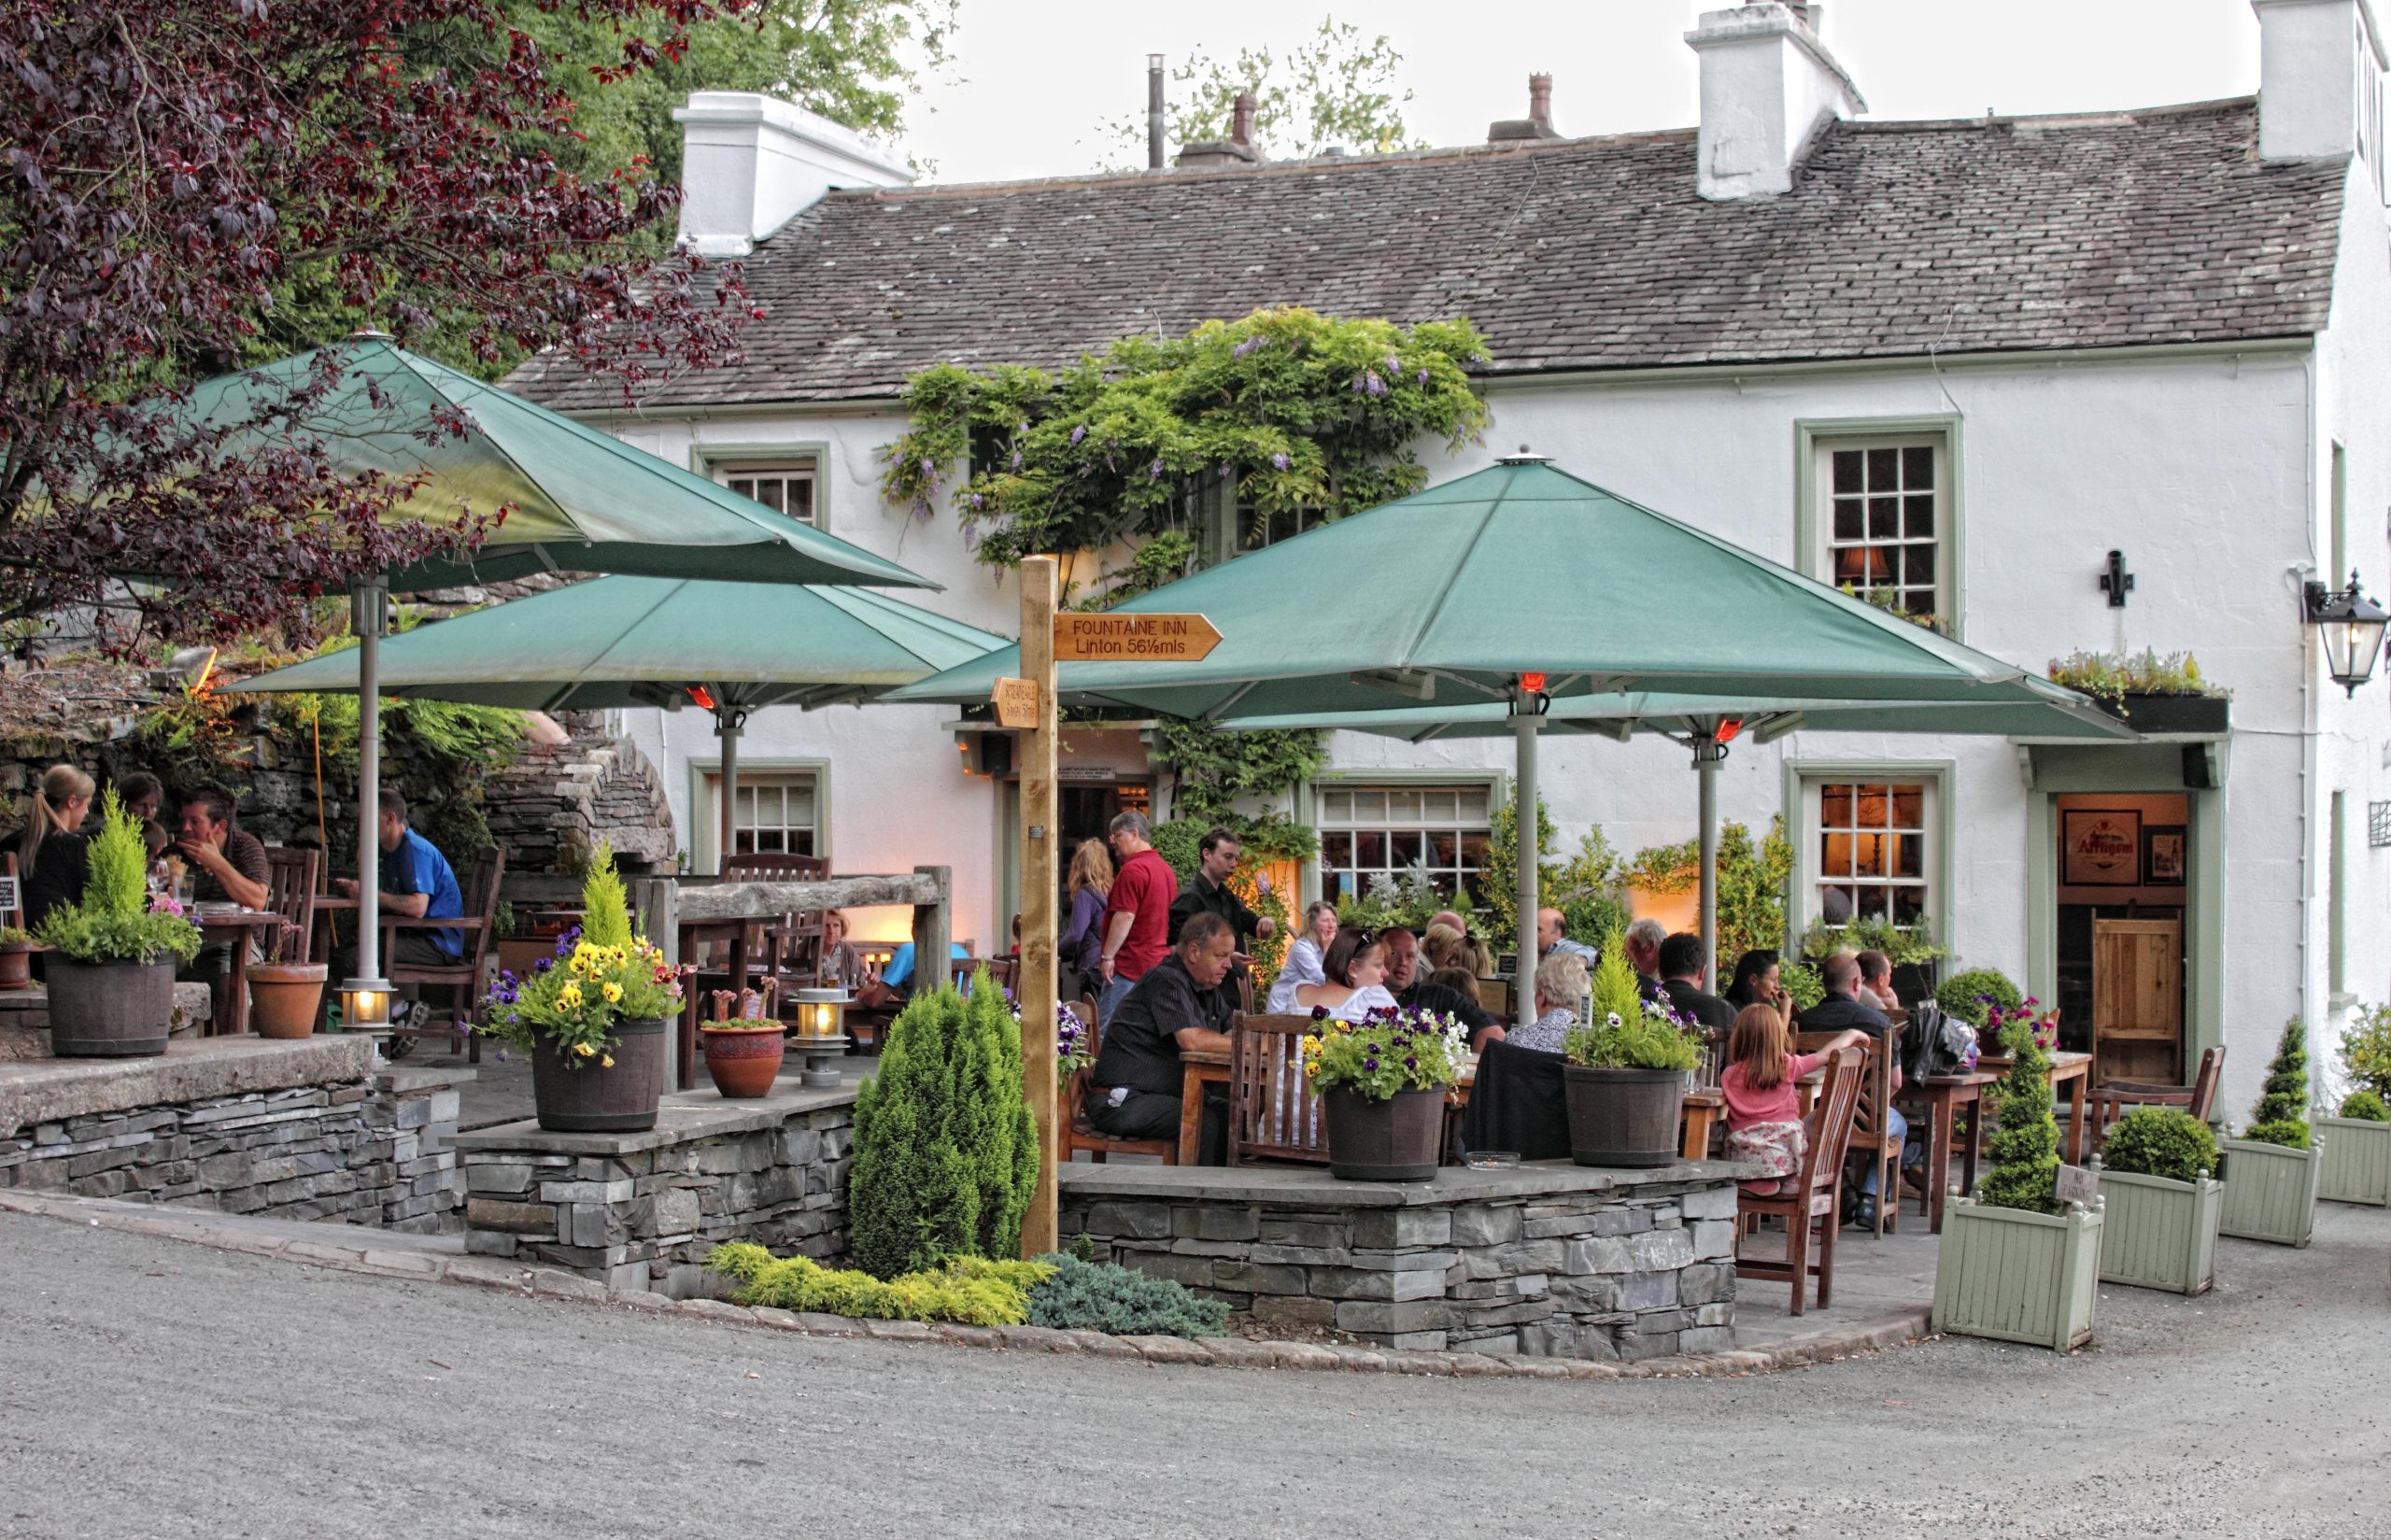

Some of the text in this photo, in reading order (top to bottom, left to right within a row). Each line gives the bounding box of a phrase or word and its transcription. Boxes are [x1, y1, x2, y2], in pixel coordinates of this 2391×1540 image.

[1073, 620, 1187, 636] FOUNTAINE INN
[1076, 639, 1122, 654] Linton
